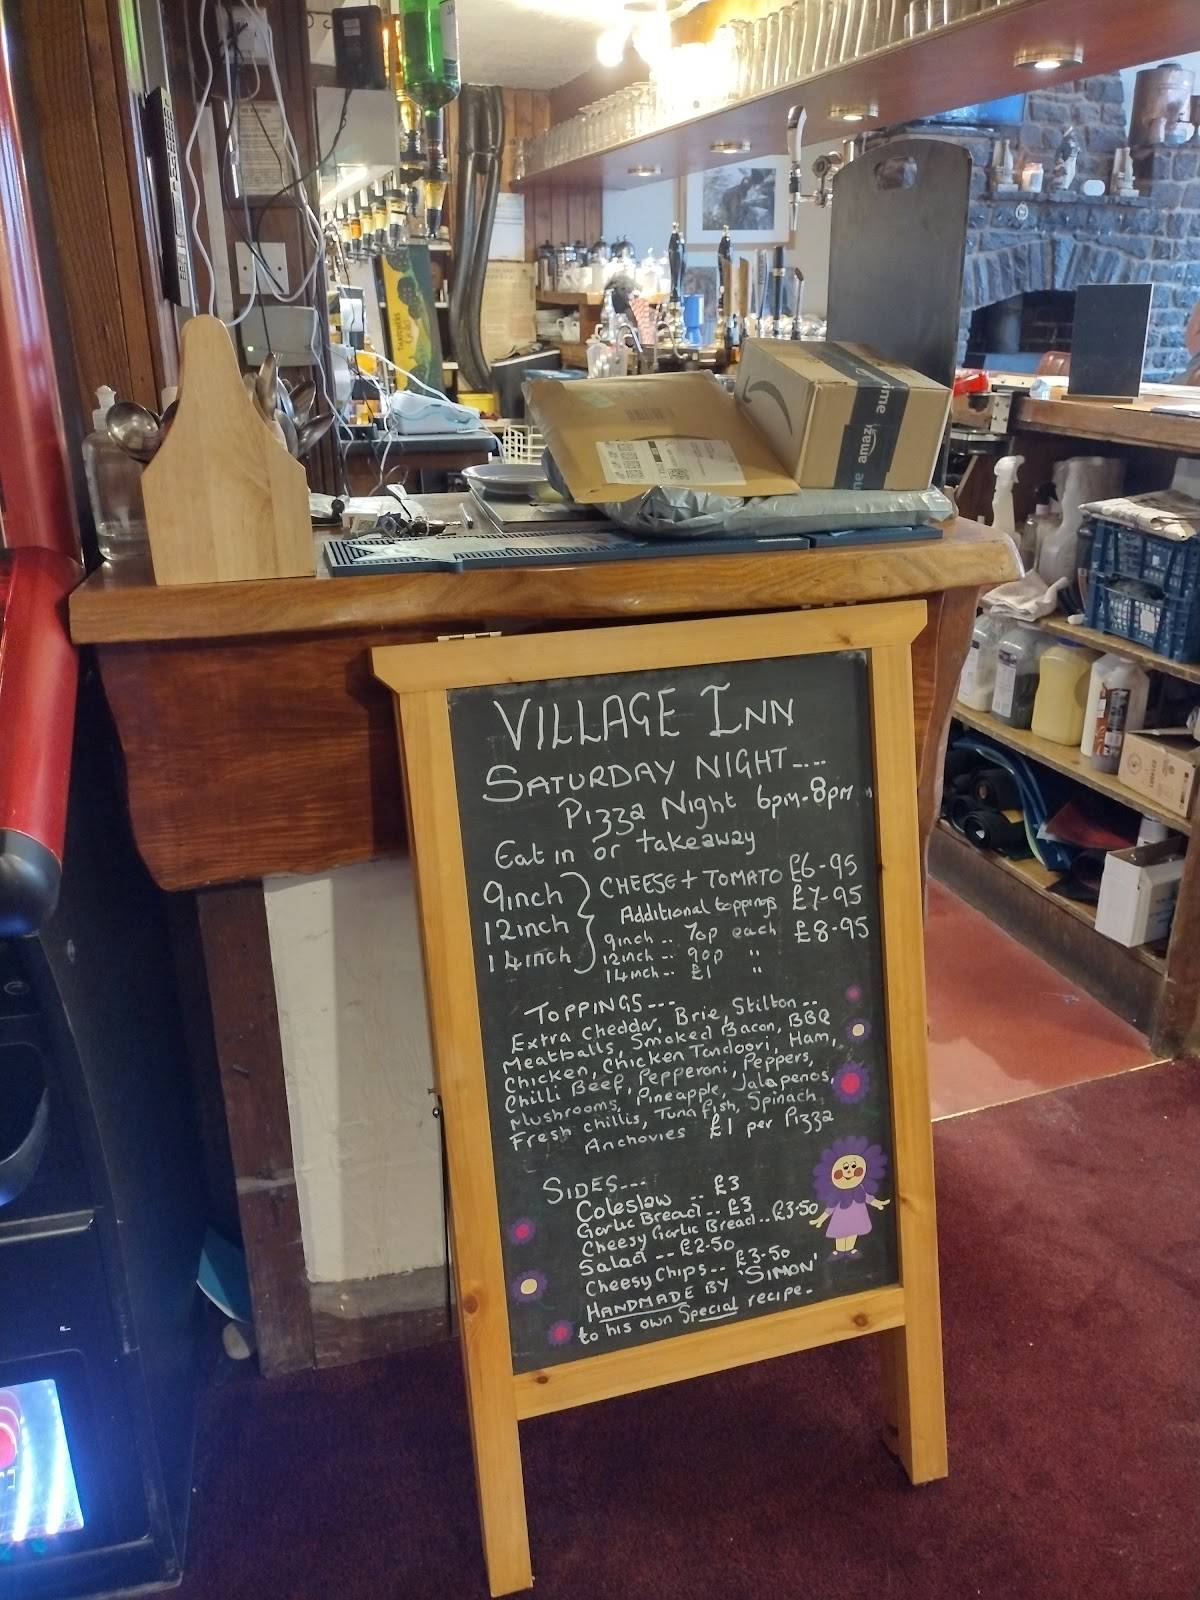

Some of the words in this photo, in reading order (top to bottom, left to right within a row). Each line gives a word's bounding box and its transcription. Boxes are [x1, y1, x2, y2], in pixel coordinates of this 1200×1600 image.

[493, 687, 680, 751] VILLAGE
[700, 682, 793, 737] INN
[483, 759, 675, 802] SATURDAY
[558, 797, 645, 843] Pizza
[662, 790, 736, 829] Night
[495, 840, 545, 869] Eat
[555, 849, 575, 864] in
[594, 844, 620, 861] or
[636, 829, 755, 855] takeaway
[483, 881, 563, 912] 9inch
[702, 868, 783, 888] TOMATO
[485, 914, 569, 945] 12inch
[620, 898, 711, 925] Additional
[715, 896, 777, 918] toppings
[684, 922, 718, 944] 70p
[732, 922, 776, 939] each
[688, 947, 723, 964] 90p
[691, 963, 711, 980] £1
[503, 1042, 623, 1074] Meatballs,
[631, 1025, 712, 1050] Smoked
[721, 1021, 782, 1037] Bacon,
[789, 1009, 831, 1028] BBQ
[512, 1032, 571, 1054] Extra
[582, 1018, 662, 1040] Cheddar,
[675, 1006, 729, 1026] Brie,
[505, 1066, 597, 1093] Chicken,
[689, 1035, 778, 1058] Tandoori,
[789, 1030, 836, 1048] Ham,
[505, 1085, 561, 1113] Chilli
[571, 1073, 632, 1097] Beef,
[639, 1060, 737, 1087] Pepperoni,
[743, 1051, 813, 1074] Peppers,
[509, 1126, 572, 1151] Fresh
[654, 1106, 697, 1121] Tuna
[747, 1088, 817, 1114] Spinach
[510, 1099, 621, 1131] Mushrooms,
[636, 1082, 726, 1106] Pineapple,
[732, 1071, 834, 1091] Jalapenos,
[584, 1119, 686, 1155] Anchovies
[709, 1113, 733, 1139] £1
[747, 1118, 773, 1138] per
[785, 1106, 834, 1134] Pizza
[576, 1193, 672, 1223] Coleslaw
[714, 1174, 740, 1196] £3
[576, 1218, 636, 1239] Garlic
[728, 1195, 752, 1216] £3
[581, 1233, 647, 1258] Cheesy
[652, 1222, 699, 1241] Garlic
[578, 1250, 648, 1277] Salad
[585, 1275, 652, 1297] Cheesy
[586, 1285, 695, 1324] HANDMADE
[705, 1278, 729, 1295] BY
[578, 1326, 599, 1345] to
[605, 1320, 633, 1337] his
[640, 1314, 673, 1330] own
[678, 1296, 739, 1325] Special
